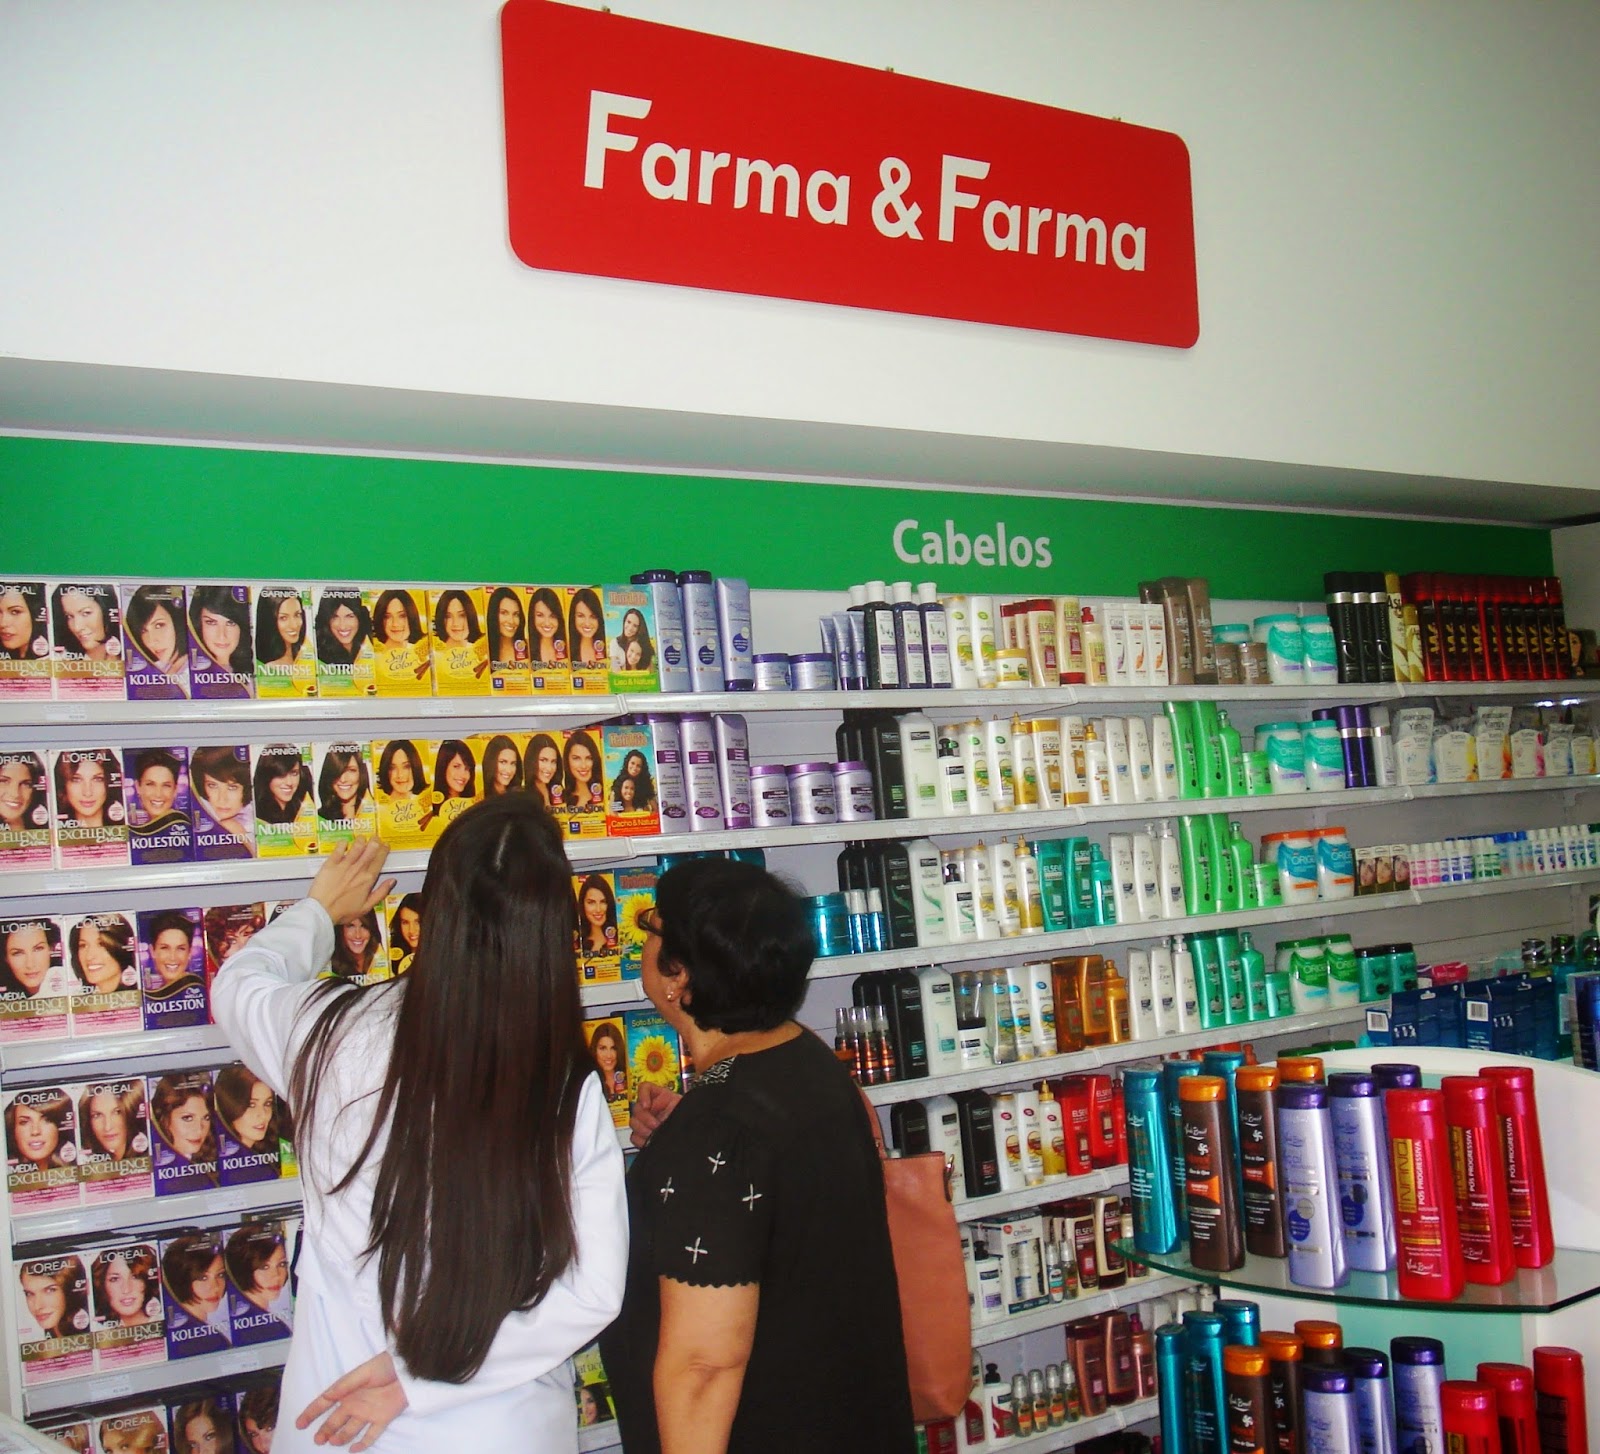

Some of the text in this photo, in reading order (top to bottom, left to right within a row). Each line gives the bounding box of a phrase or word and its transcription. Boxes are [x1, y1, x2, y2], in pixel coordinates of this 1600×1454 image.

[584, 90, 1147, 271] Farma & Farma
[893, 519, 1052, 568] Cabelos
[261, 590, 301, 599] GARNIER
[322, 590, 361, 599] GARNIER
[386, 649, 409, 665] Soft
[447, 649, 469, 665] Soft
[56, 661, 121, 672] EXCELLENCE
[258, 664, 312, 676] NUTRISSE
[319, 664, 372, 676] NUTRISSE
[389, 660, 415, 672] Color
[450, 659, 476, 671] Color
[130, 673, 188, 685] KOLESTON
[194, 672, 251, 684] KOLESTON
[261, 748, 301, 756] GARNIER
[329, 745, 361, 753] ARNIER
[62, 753, 111, 763] L'ORÉAL
[391, 799, 414, 815] Soft
[319, 818, 374, 831] NUTRISSE
[394, 811, 418, 823] Color
[58, 827, 125, 842] EXCELLENCE
[258, 823, 313, 836] NUTRISSE
[132, 836, 190, 849] KOLESTON
[197, 834, 251, 846] KOLESTON
[1, 922, 51, 934] L'ORÉAL
[75, 916, 124, 928] L'ORÉAL
[72, 992, 137, 1007] EXCELLENCE
[147, 999, 204, 1014] KOLESTON
[87, 1083, 134, 1097] L'ORÉAL
[13, 1091, 62, 1106] L'ORÉAL
[1506, 1117, 1515, 1163] PROGRESSIVA
[1466, 1129, 1474, 1176] PROGRESSIVA
[82, 1157, 150, 1177] EXCELLENCE
[223, 1152, 279, 1170] KOLESTON
[9, 1166, 78, 1186] EXCELLENCE
[158, 1161, 216, 1180] KOLESTON
[1414, 1141, 1425, 1205] PÓS PROGRESSIVA
[100, 1249, 147, 1264] L'ORÉAL
[26, 1260, 75, 1275] L'ORÉAL
[96, 1323, 162, 1343] EXCELLENCE
[22, 1335, 90, 1355] EXCELLENCE
[106, 1416, 154, 1431] L'ORÉAL
